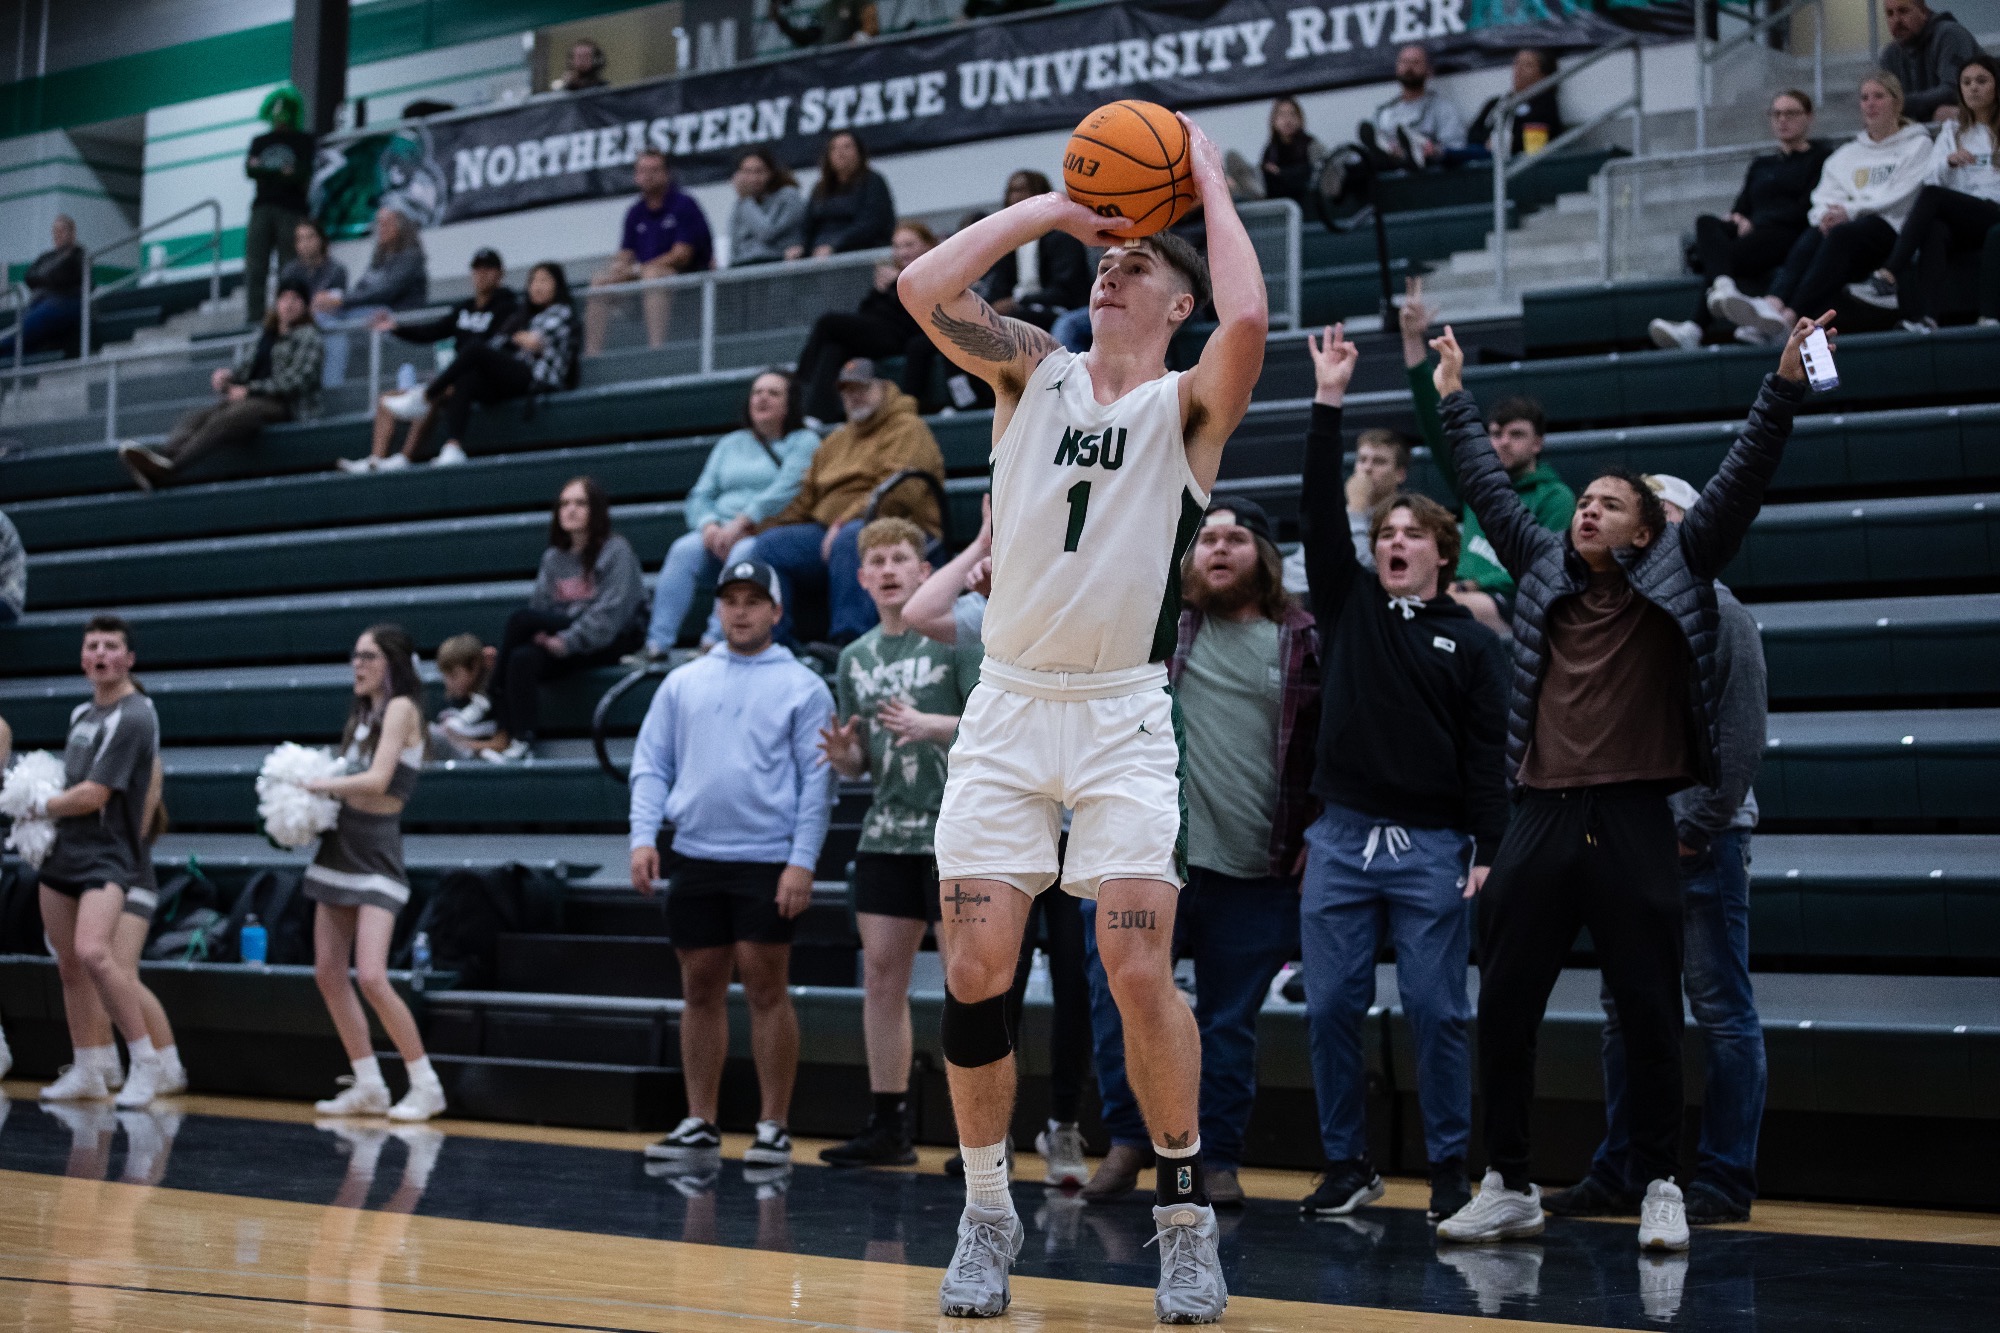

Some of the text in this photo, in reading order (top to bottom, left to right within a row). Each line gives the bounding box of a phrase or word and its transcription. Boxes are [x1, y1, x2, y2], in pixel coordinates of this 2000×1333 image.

[452, 96, 792, 193] NORTHEASTERN
[799, 70, 947, 135] STATE
[957, 18, 1276, 110] UNIVERSITY
[1054, 425, 1127, 471] NSU
[1064, 480, 1092, 552] 1
[1107, 910, 1156, 931] 2001
